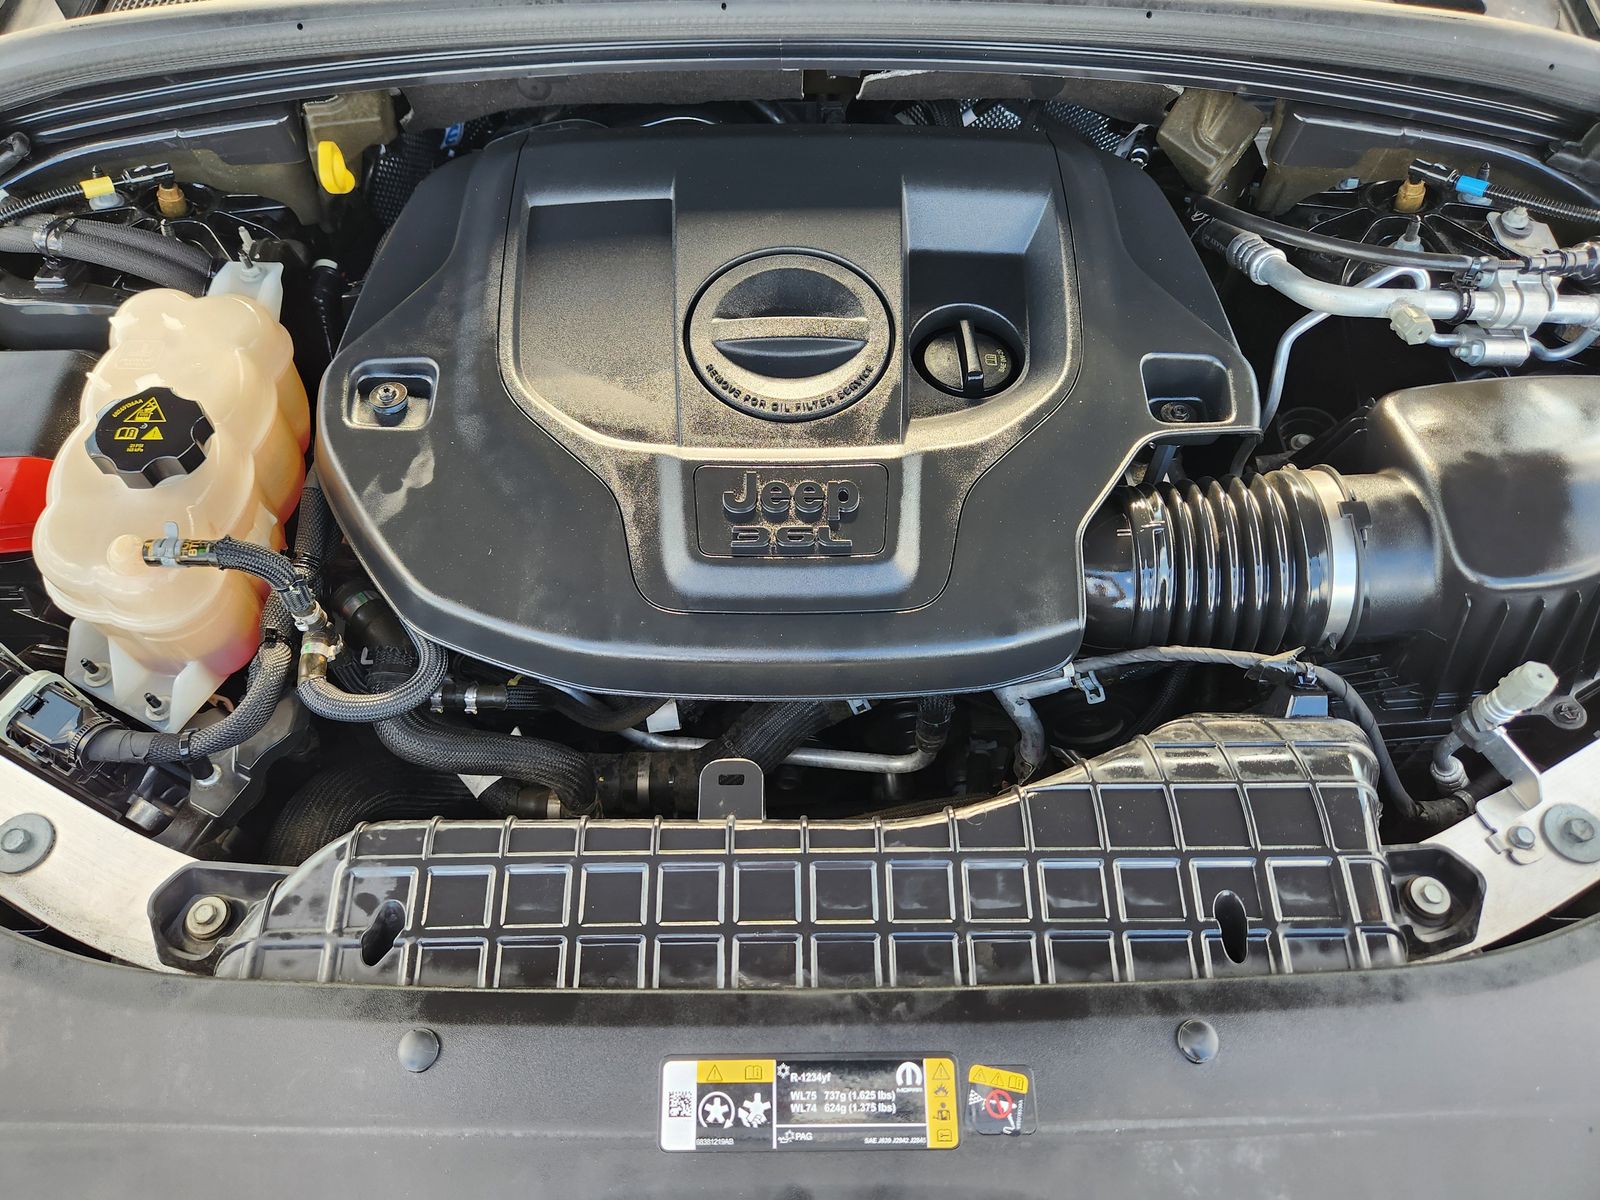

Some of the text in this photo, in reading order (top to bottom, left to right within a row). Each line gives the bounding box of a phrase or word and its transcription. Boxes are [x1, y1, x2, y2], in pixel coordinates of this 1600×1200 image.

[705, 363, 874, 413] REMOVE FOR OIL FILTER SERVICE
[722, 470, 860, 521] Jeep
[790, 1071, 831, 1084] R-1234yf
[790, 1089, 896, 1103] WL75 737g (1.625 lbs)
[790, 1102, 897, 1115] WL74 624g (1.375 lbs)
[795, 1132, 813, 1141] PAG
